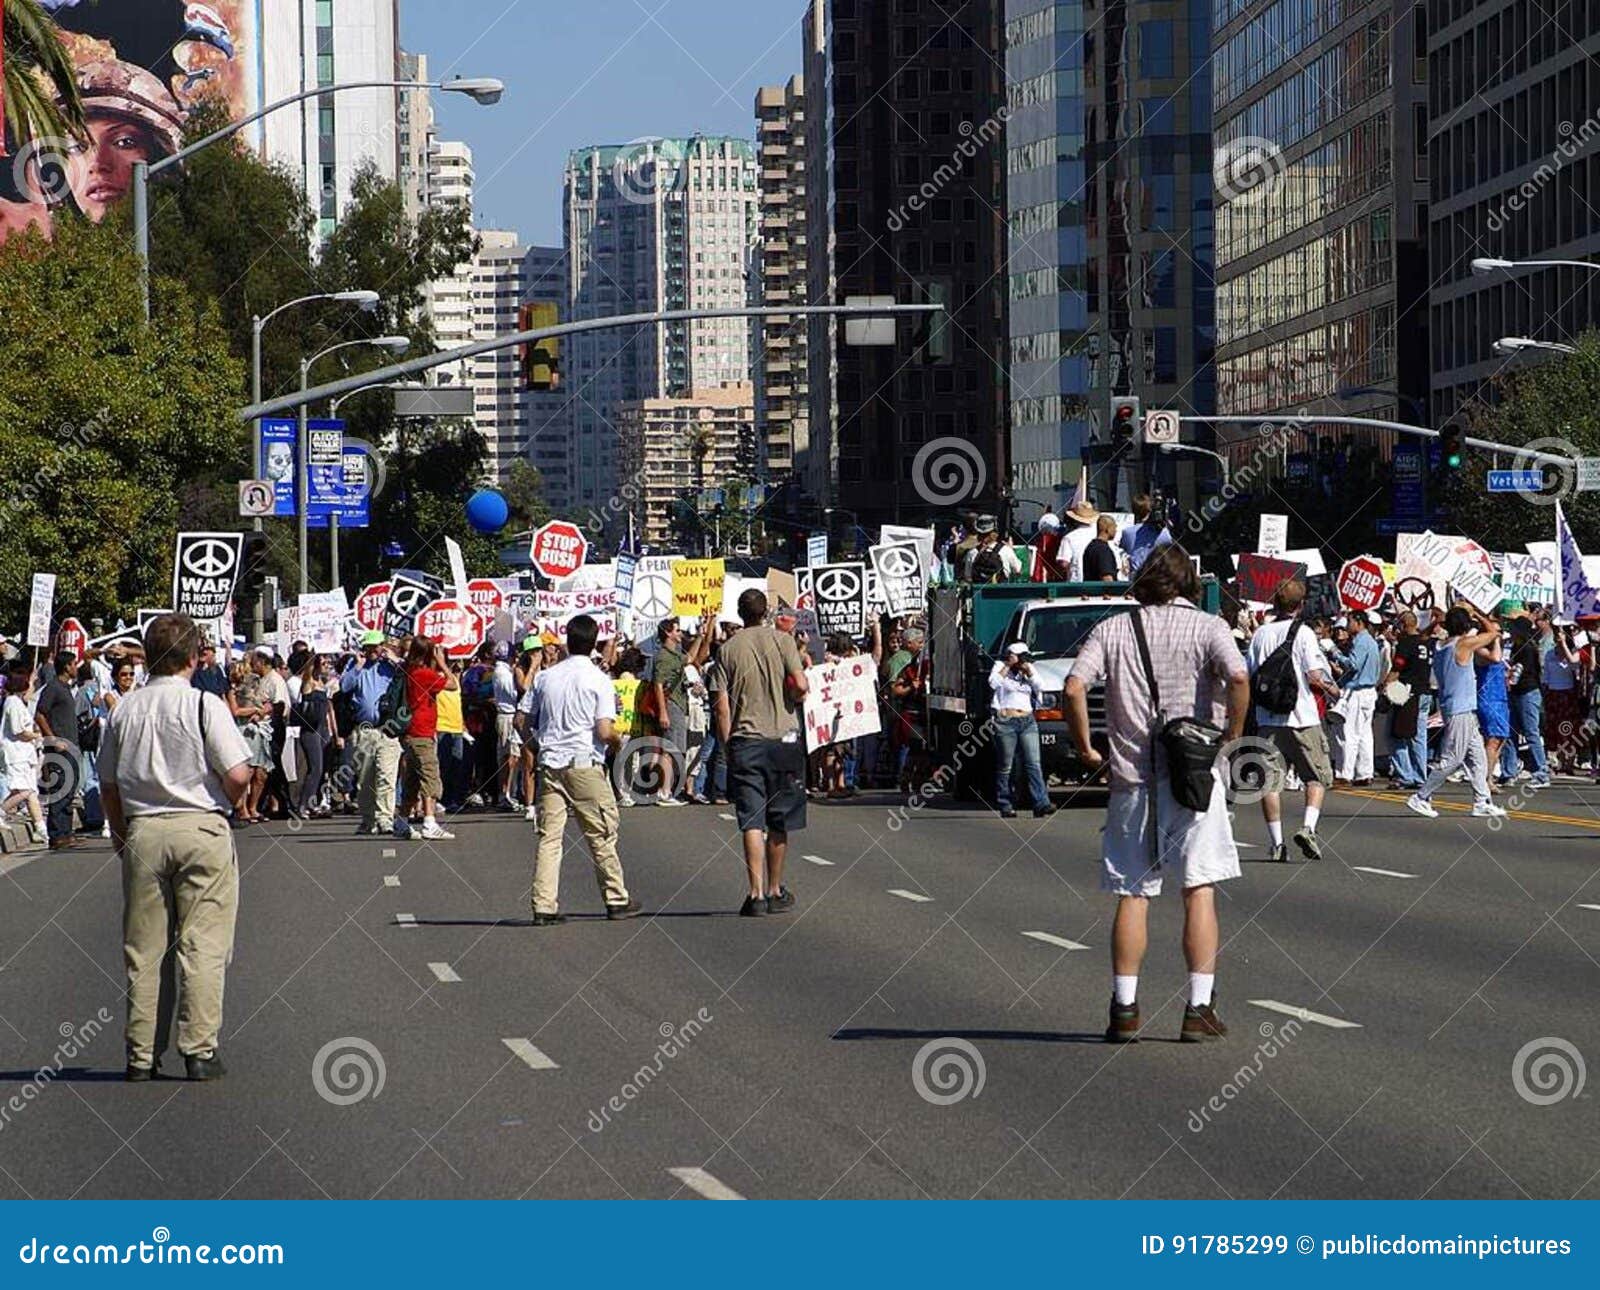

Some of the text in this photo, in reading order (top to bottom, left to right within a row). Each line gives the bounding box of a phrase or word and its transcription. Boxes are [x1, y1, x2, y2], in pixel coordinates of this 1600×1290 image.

[1491, 475, 1540, 487] Veteran
[541, 531, 580, 552] STOP
[1413, 534, 1451, 566] NO
[539, 548, 577, 570] BUSH
[1506, 554, 1554, 574] WAR
[674, 566, 708, 577] WHY
[1347, 564, 1382, 589] STOP
[1515, 571, 1543, 586] FOR
[181, 576, 230, 592] WAR
[1341, 579, 1376, 606] BUSH
[1503, 583, 1556, 602] PROFIT
[181, 592, 191, 602] IS
[193, 593, 213, 604] NOT
[362, 592, 389, 610] STO
[538, 591, 617, 609] MAKE SENSE
[675, 593, 708, 605] WHY
[817, 600, 861, 615] WAR
